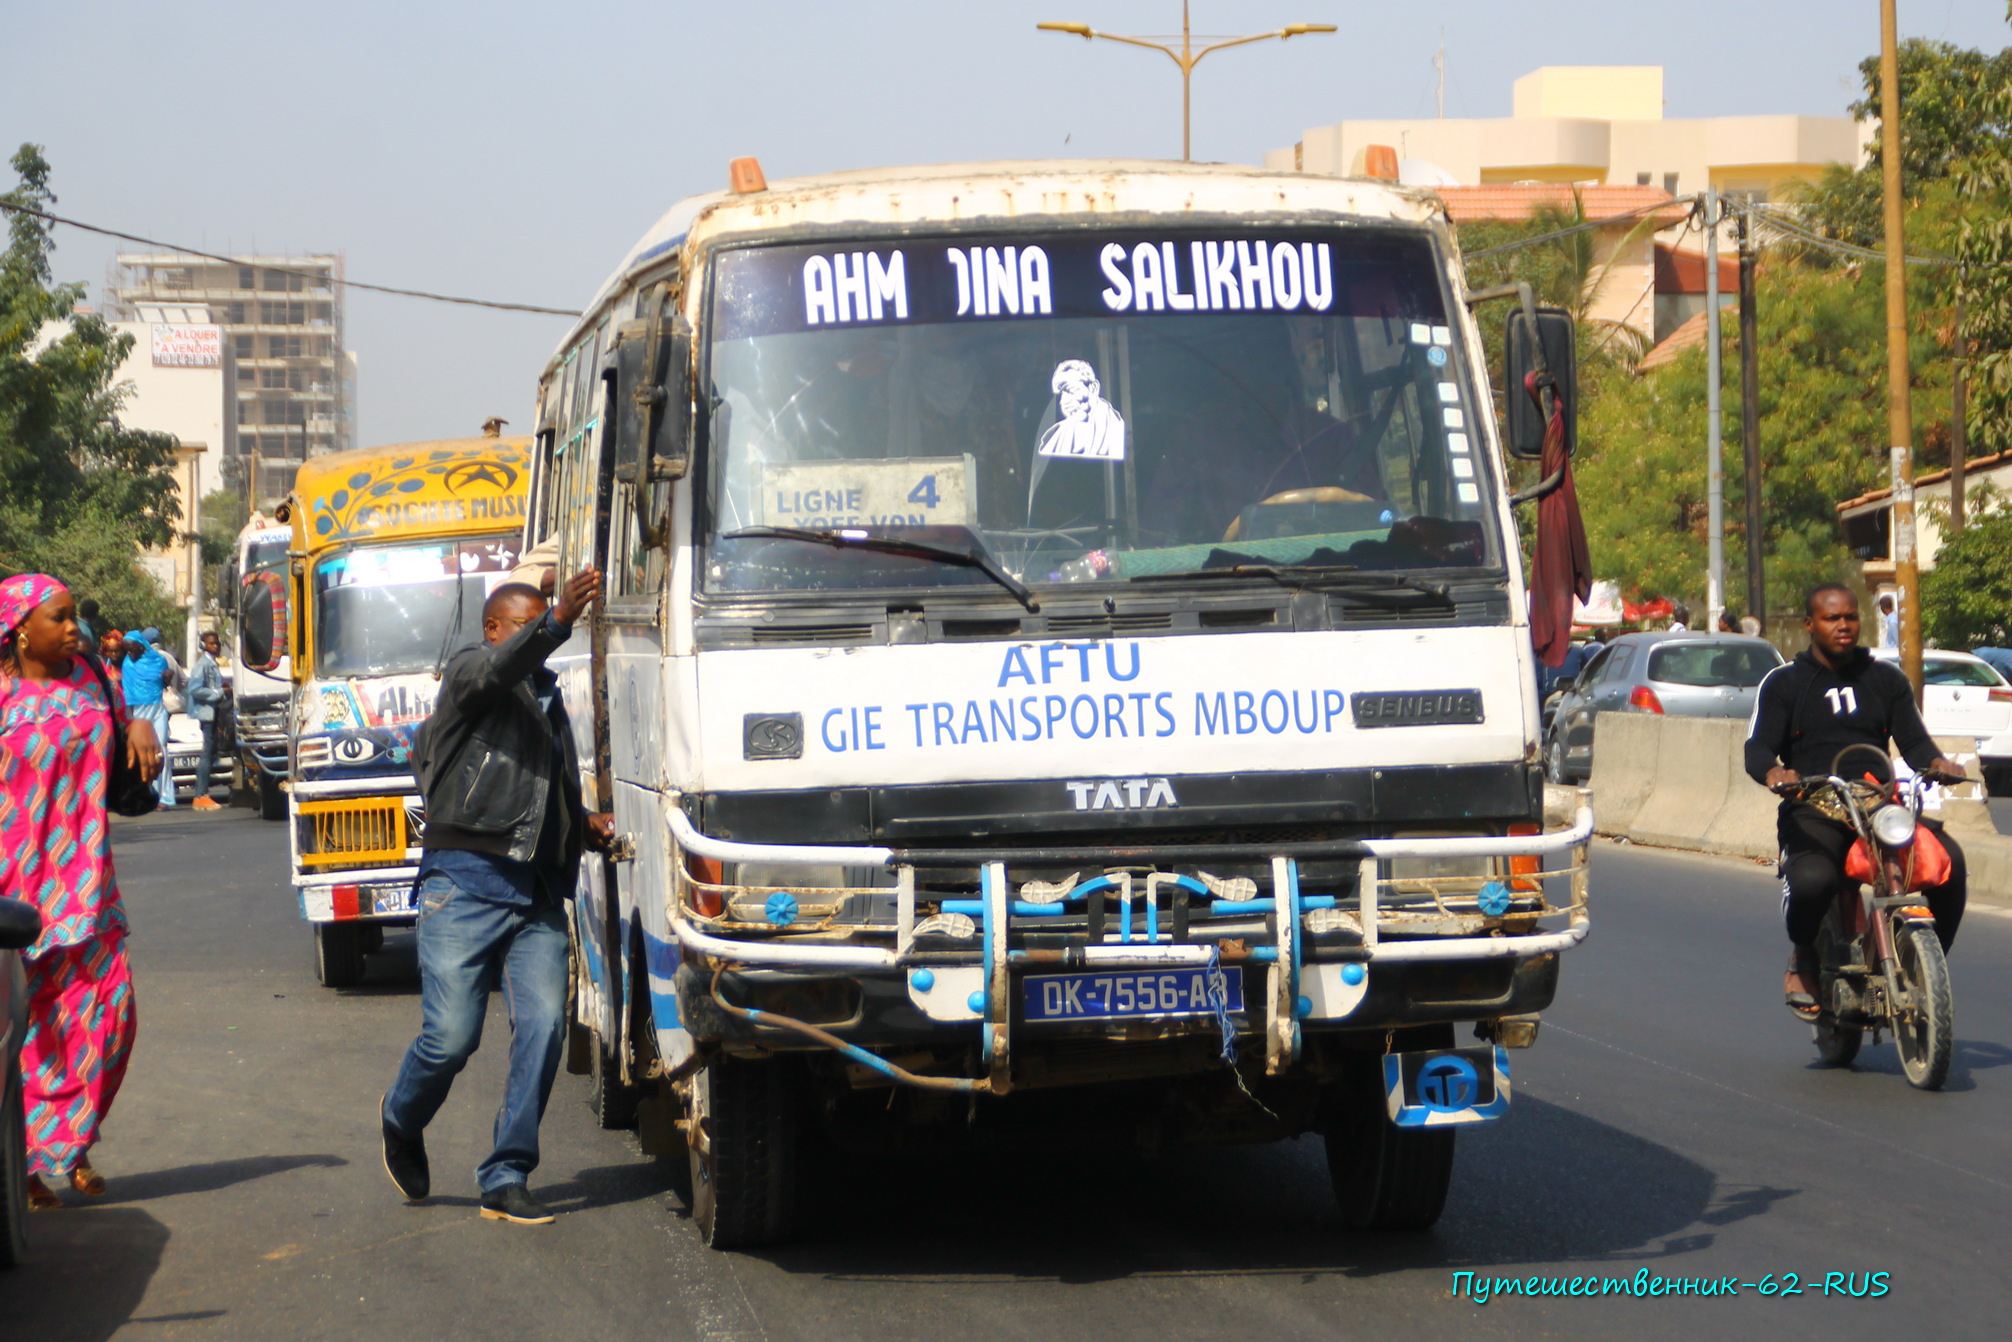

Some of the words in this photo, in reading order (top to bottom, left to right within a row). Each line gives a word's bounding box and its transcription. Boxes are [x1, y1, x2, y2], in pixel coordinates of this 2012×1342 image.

[802, 250, 908, 325] AHM
[1099, 240, 1333, 312] SALIKHOU
[171, 343, 219, 354] VENDRE
[777, 489, 862, 513] LIGNE
[907, 474, 941, 509] 4
[997, 642, 1141, 688] AFTU
[1359, 695, 1477, 719] SENBUS
[1824, 685, 1857, 715] 11
[821, 706, 886, 753] GIE
[905, 691, 1176, 748] TRANSPORTS
[1194, 688, 1345, 737] MBOUP
[1066, 777, 1180, 811] TATA
